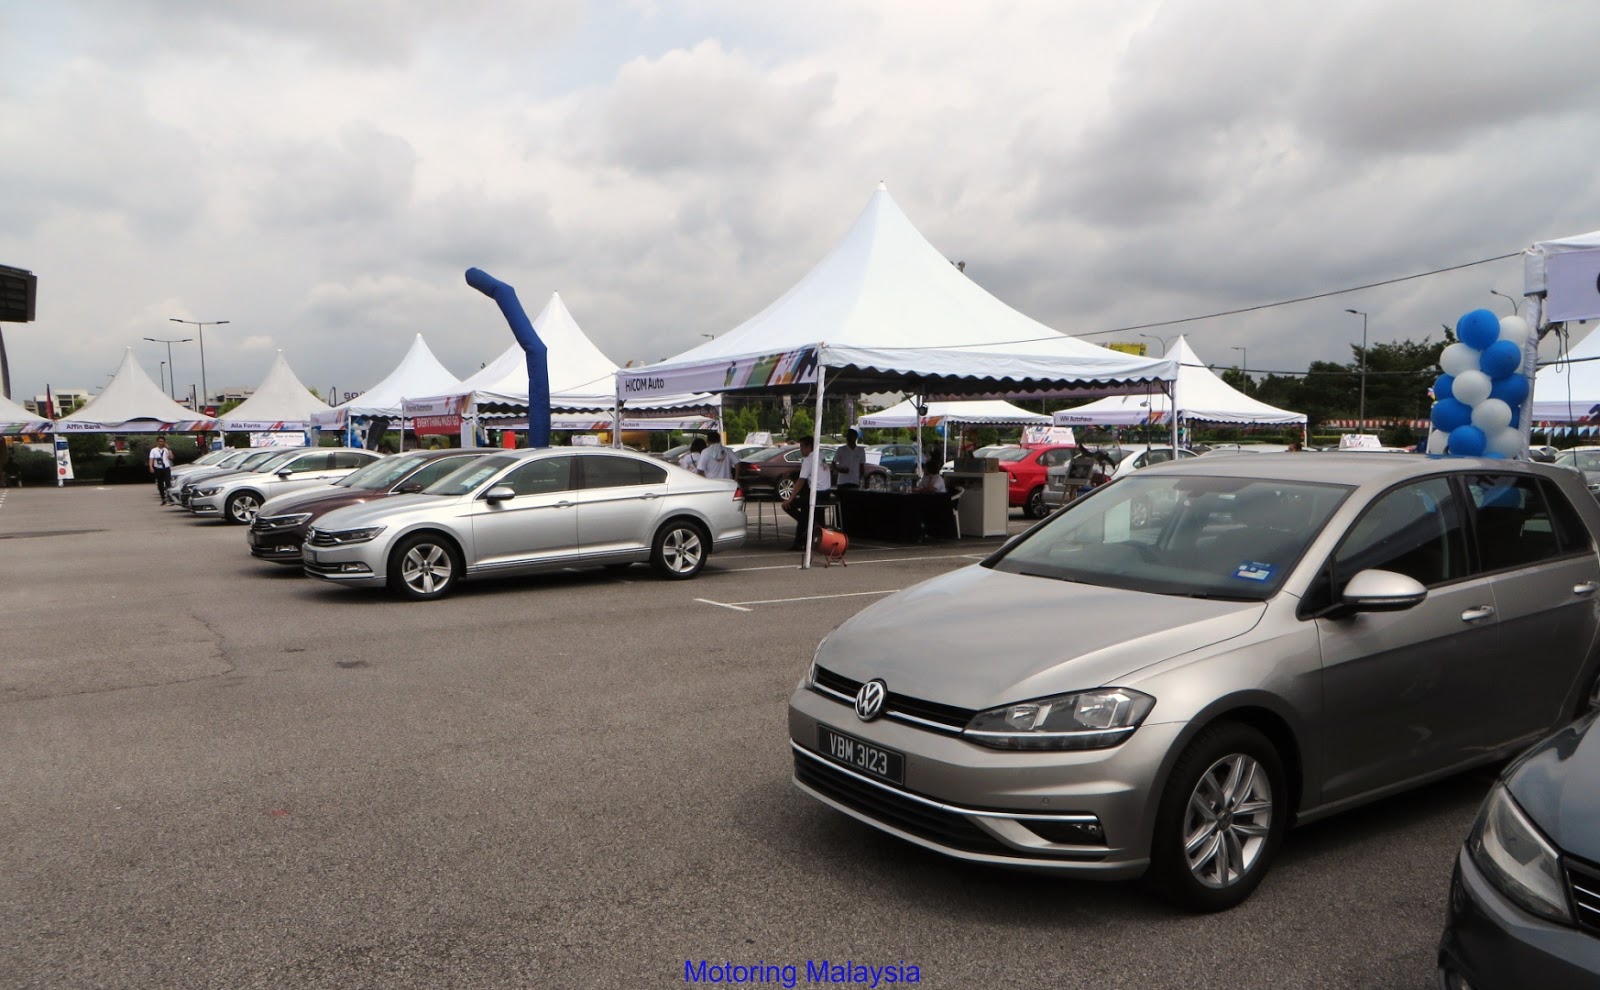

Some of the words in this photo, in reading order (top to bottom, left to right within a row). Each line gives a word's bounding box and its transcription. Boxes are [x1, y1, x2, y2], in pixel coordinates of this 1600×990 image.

[648, 377, 665, 390] Auto
[829, 732, 854, 762] VBM
[857, 744, 888, 775] 3123
